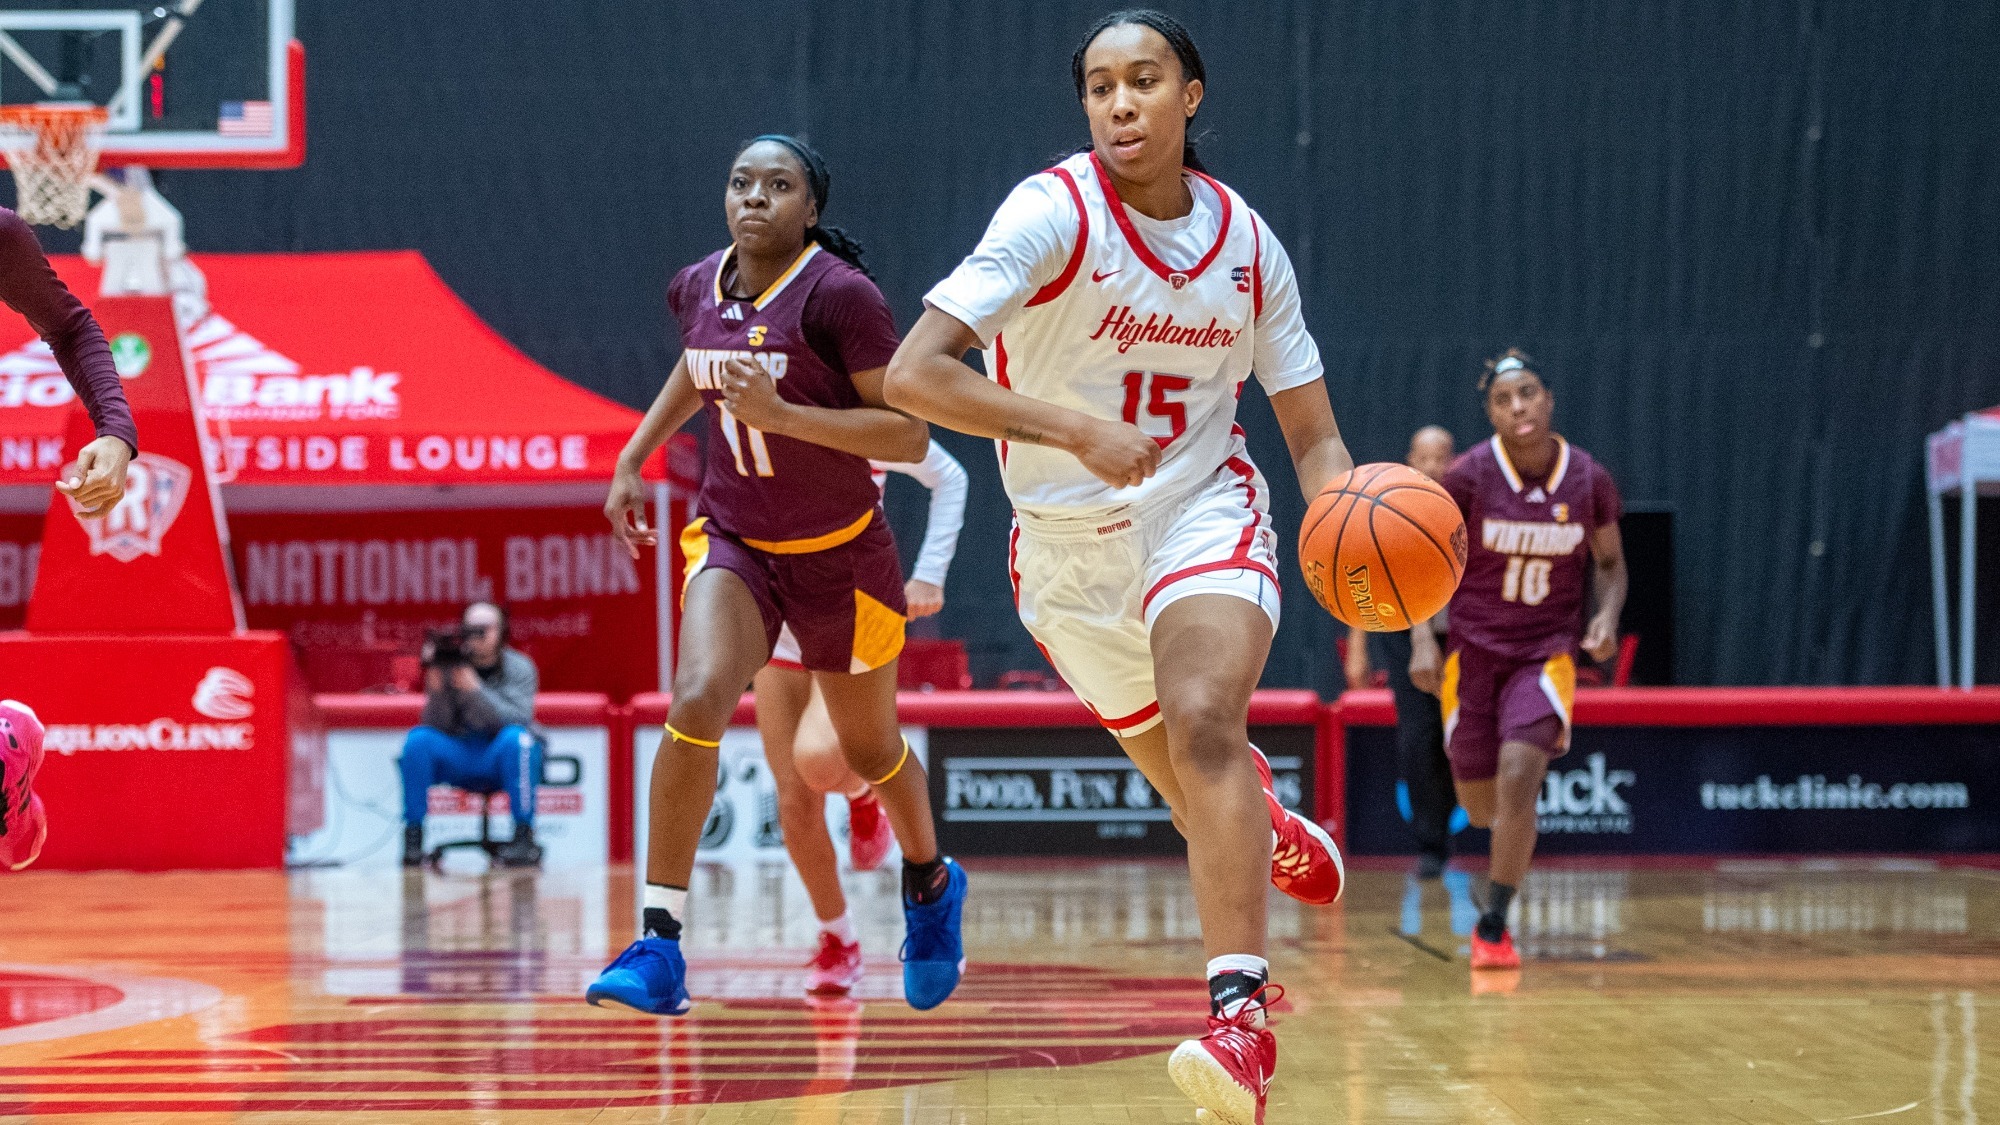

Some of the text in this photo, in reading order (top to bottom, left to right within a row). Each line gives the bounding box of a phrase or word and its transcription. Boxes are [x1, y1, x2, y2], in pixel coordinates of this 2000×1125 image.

[204, 366, 401, 407] Bank
[1121, 370, 1196, 449] 15
[389, 433, 589, 471] LOUNGE
[714, 399, 775, 478] 11
[1096, 519, 1132, 536] RADFORD
[245, 532, 642, 605] NATIONAL BANK
[1502, 555, 1553, 606] 10
[1124, 769, 1152, 809] &
[1535, 751, 1638, 816] uck
[1701, 774, 1969, 810] tuckclinic.com
